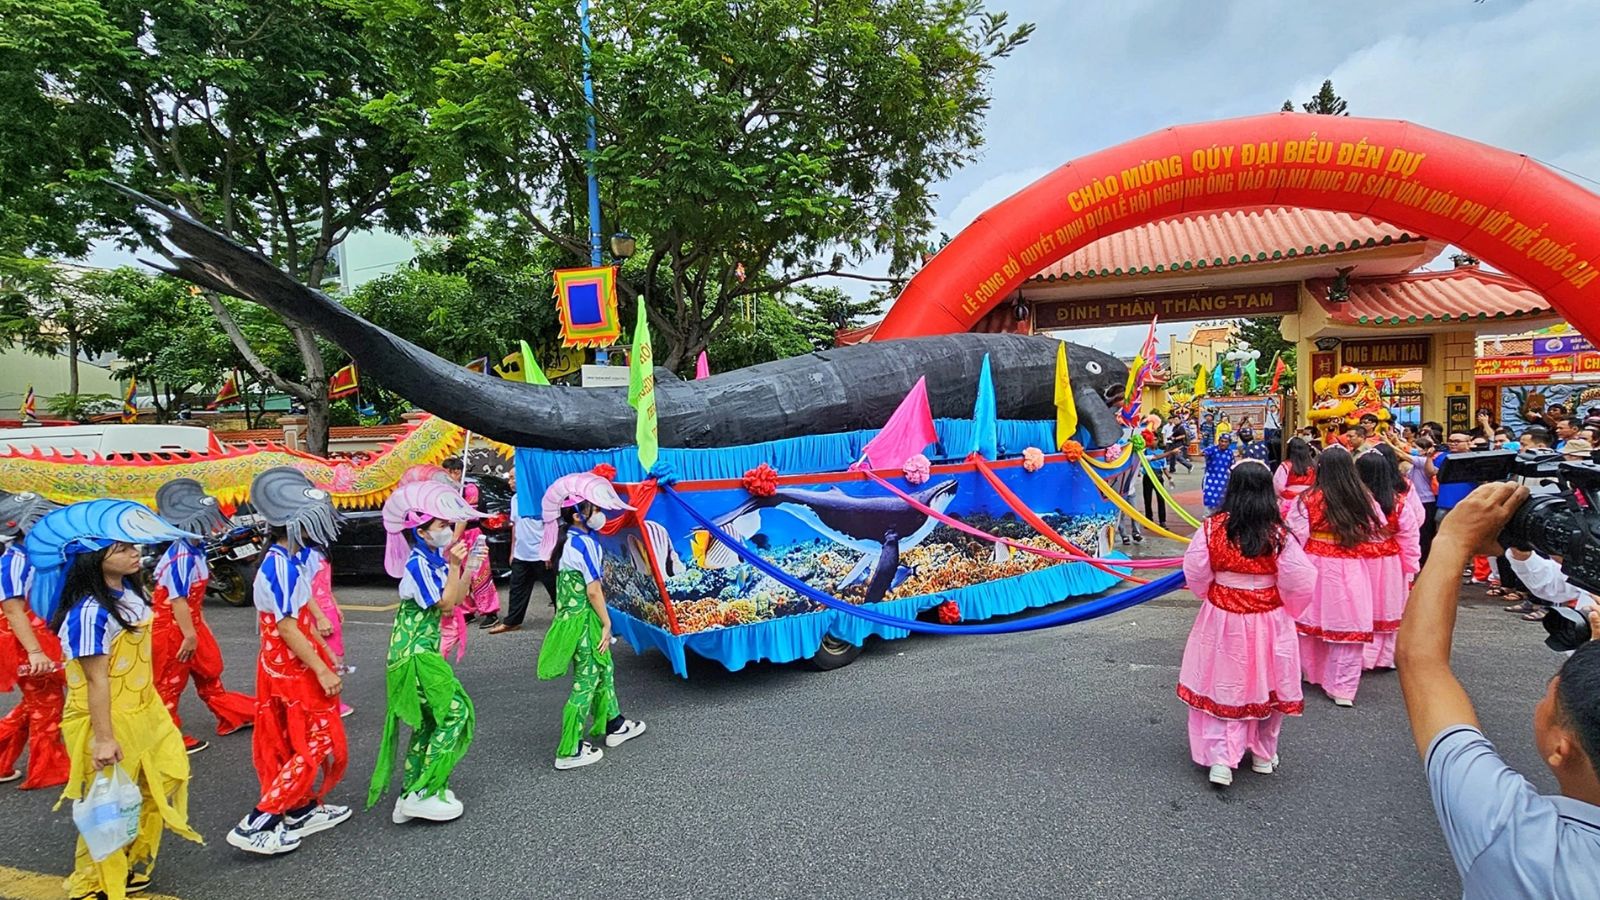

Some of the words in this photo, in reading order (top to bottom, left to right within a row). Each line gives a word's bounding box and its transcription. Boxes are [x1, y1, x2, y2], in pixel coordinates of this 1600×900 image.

[1067, 175, 1120, 212] CHÀO
[1121, 155, 1183, 191] MỪNG
[1192, 143, 1235, 173] QÚY
[1241, 141, 1278, 168] ĐẠI
[1283, 131, 1333, 164] BIỂU
[1336, 136, 1384, 169] ĐẾN
[1385, 148, 1426, 180] DỰ
[962, 293, 980, 316] LỄ
[974, 272, 1006, 303] CÔNG
[1002, 252, 1021, 279] BỐ
[1020, 232, 1057, 266] QUYẾT
[1055, 218, 1086, 245] ĐỊNH
[1085, 206, 1113, 230] ĐƯA
[1112, 193, 1129, 219] LỄ
[1129, 190, 1150, 214] HỘI
[1153, 177, 1204, 207] NGHINH
[1206, 173, 1234, 195] ÔNG
[1237, 167, 1264, 191] VÀO
[1308, 169, 1344, 194] MỤC
[1343, 172, 1363, 194] DI
[1361, 171, 1398, 199] SẢN
[1395, 180, 1430, 208] VĂN
[1420, 189, 1459, 217] HÓA
[1452, 199, 1487, 226] PHI
[1501, 222, 1548, 251] THỂ
[1526, 237, 1578, 271] QUỐC
[1561, 259, 1600, 290] GIA
